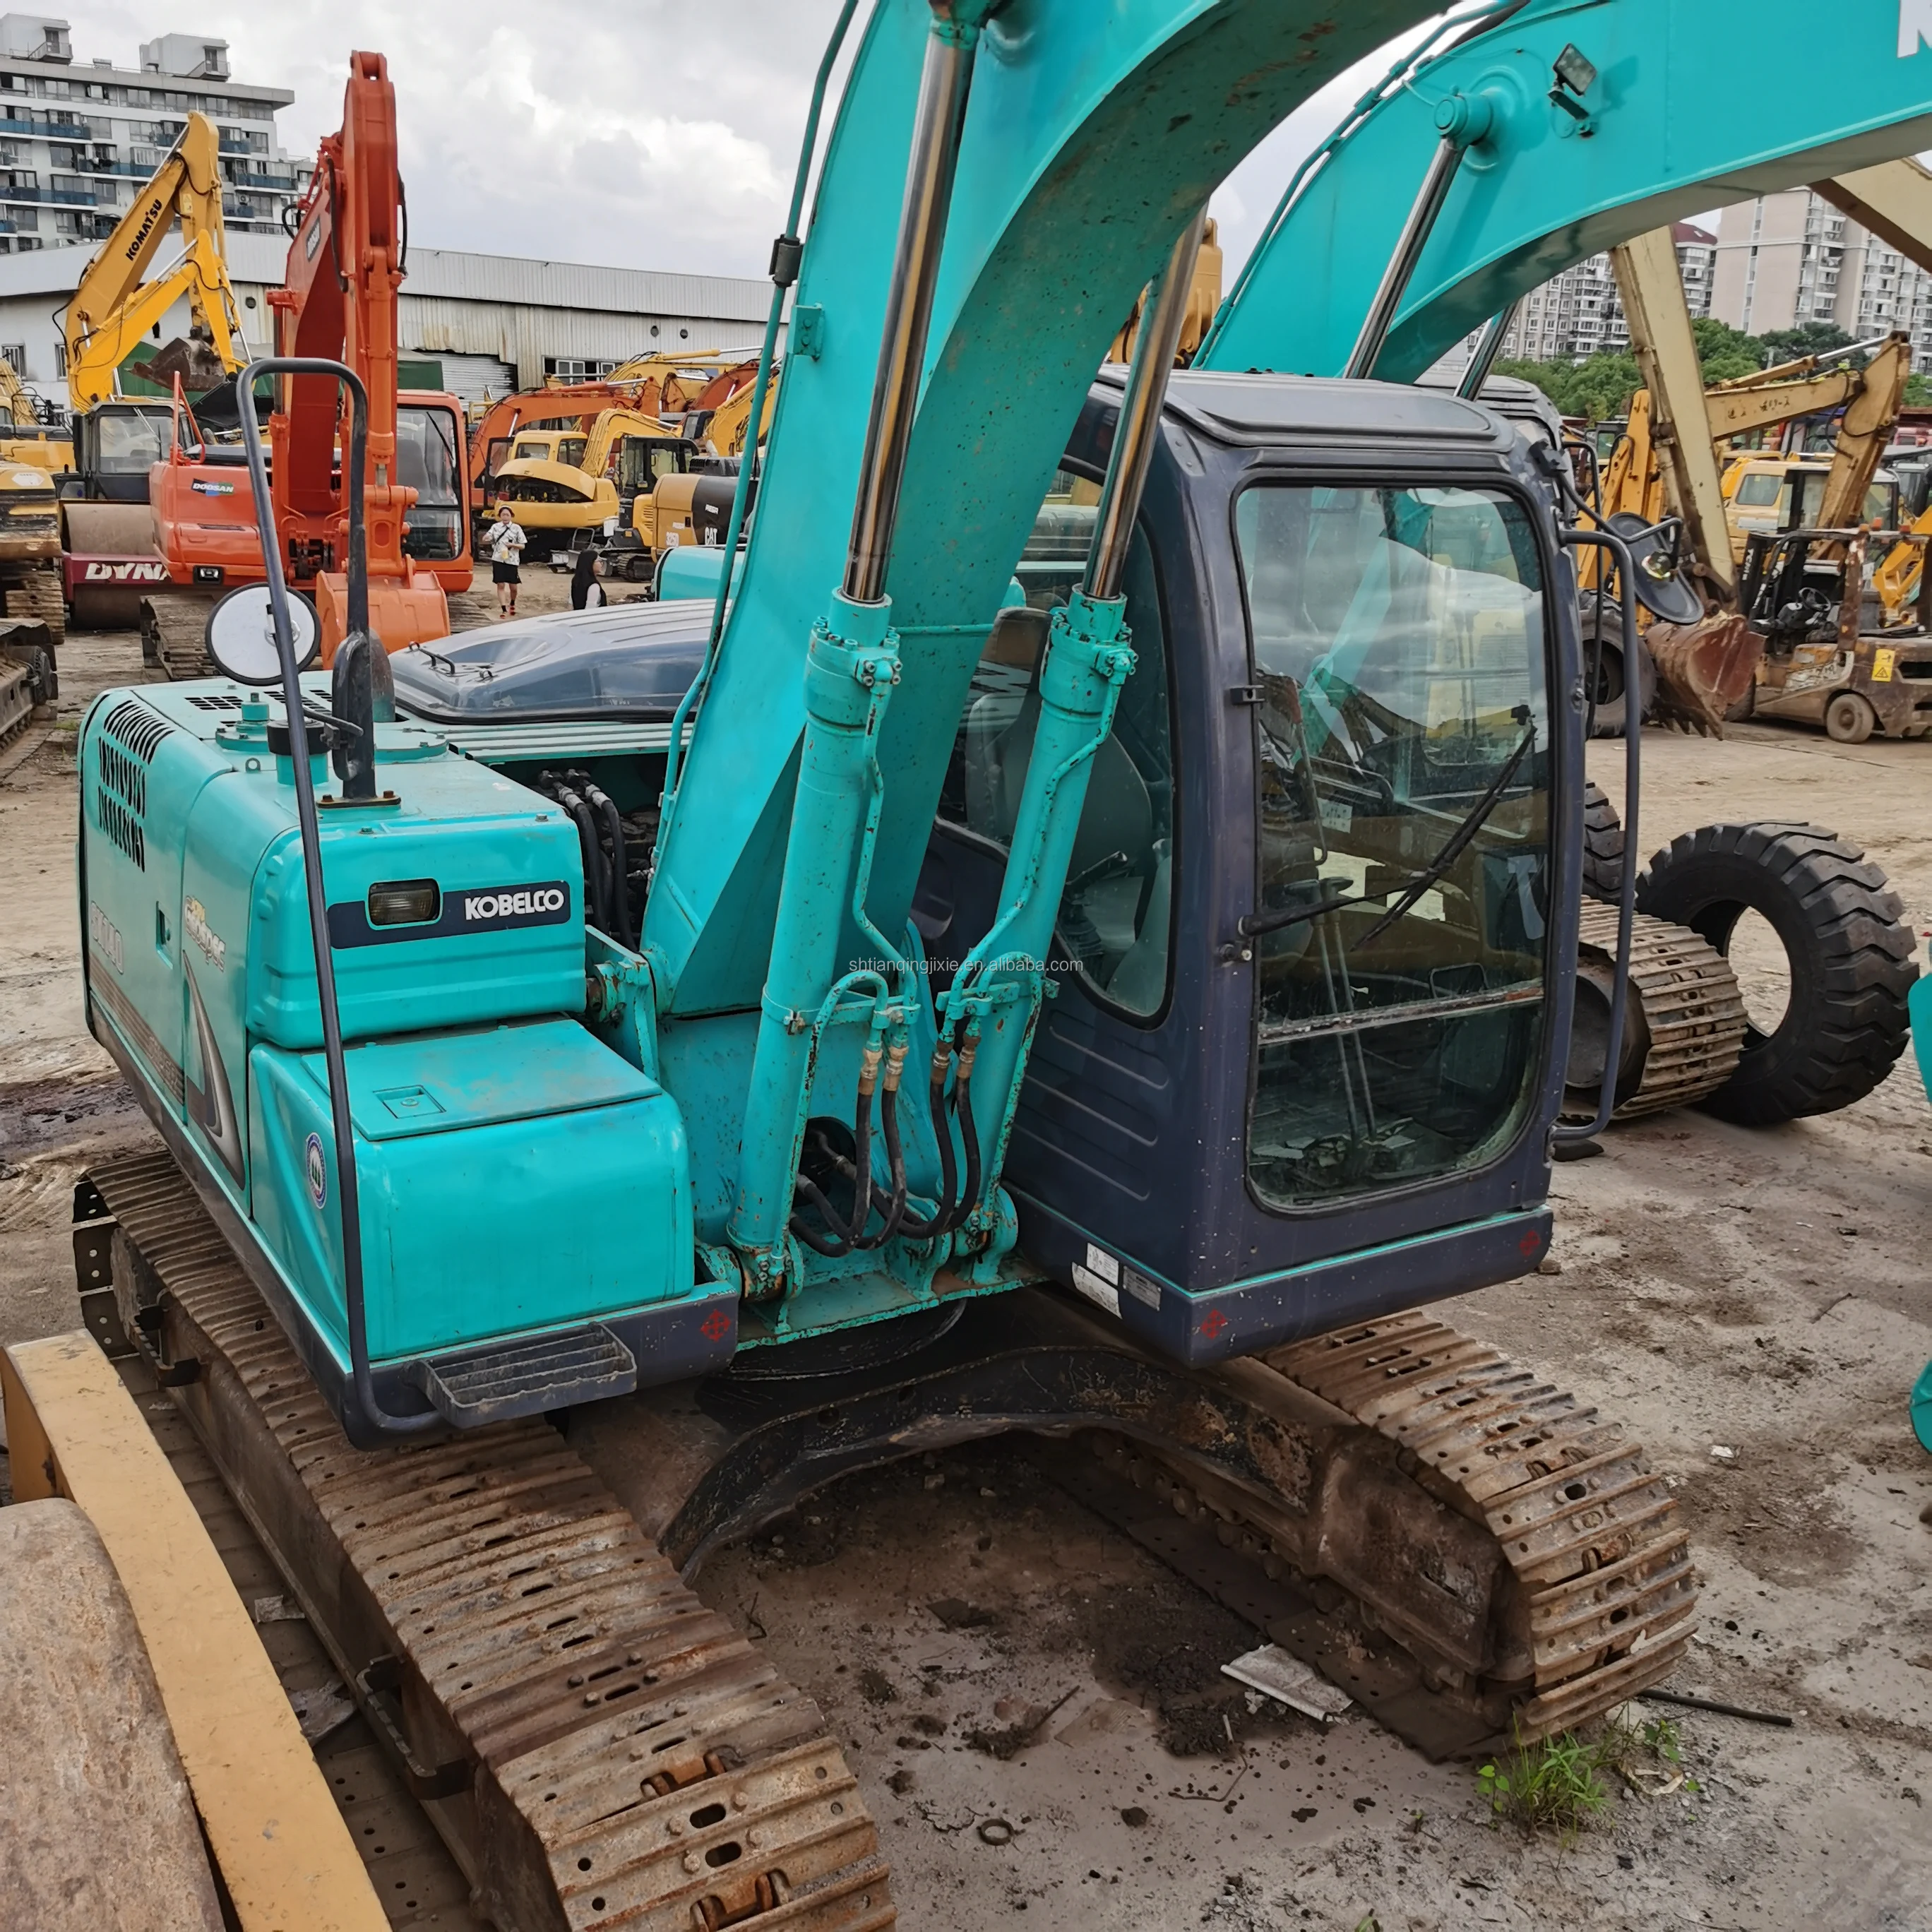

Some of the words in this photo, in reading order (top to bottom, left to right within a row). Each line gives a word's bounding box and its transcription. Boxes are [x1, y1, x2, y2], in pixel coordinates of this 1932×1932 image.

[126, 198, 162, 261] KOMATSU
[193, 482, 234, 492] DOOSAN
[705, 527, 717, 545] CAT
[465, 889, 564, 920] KOBELCO
